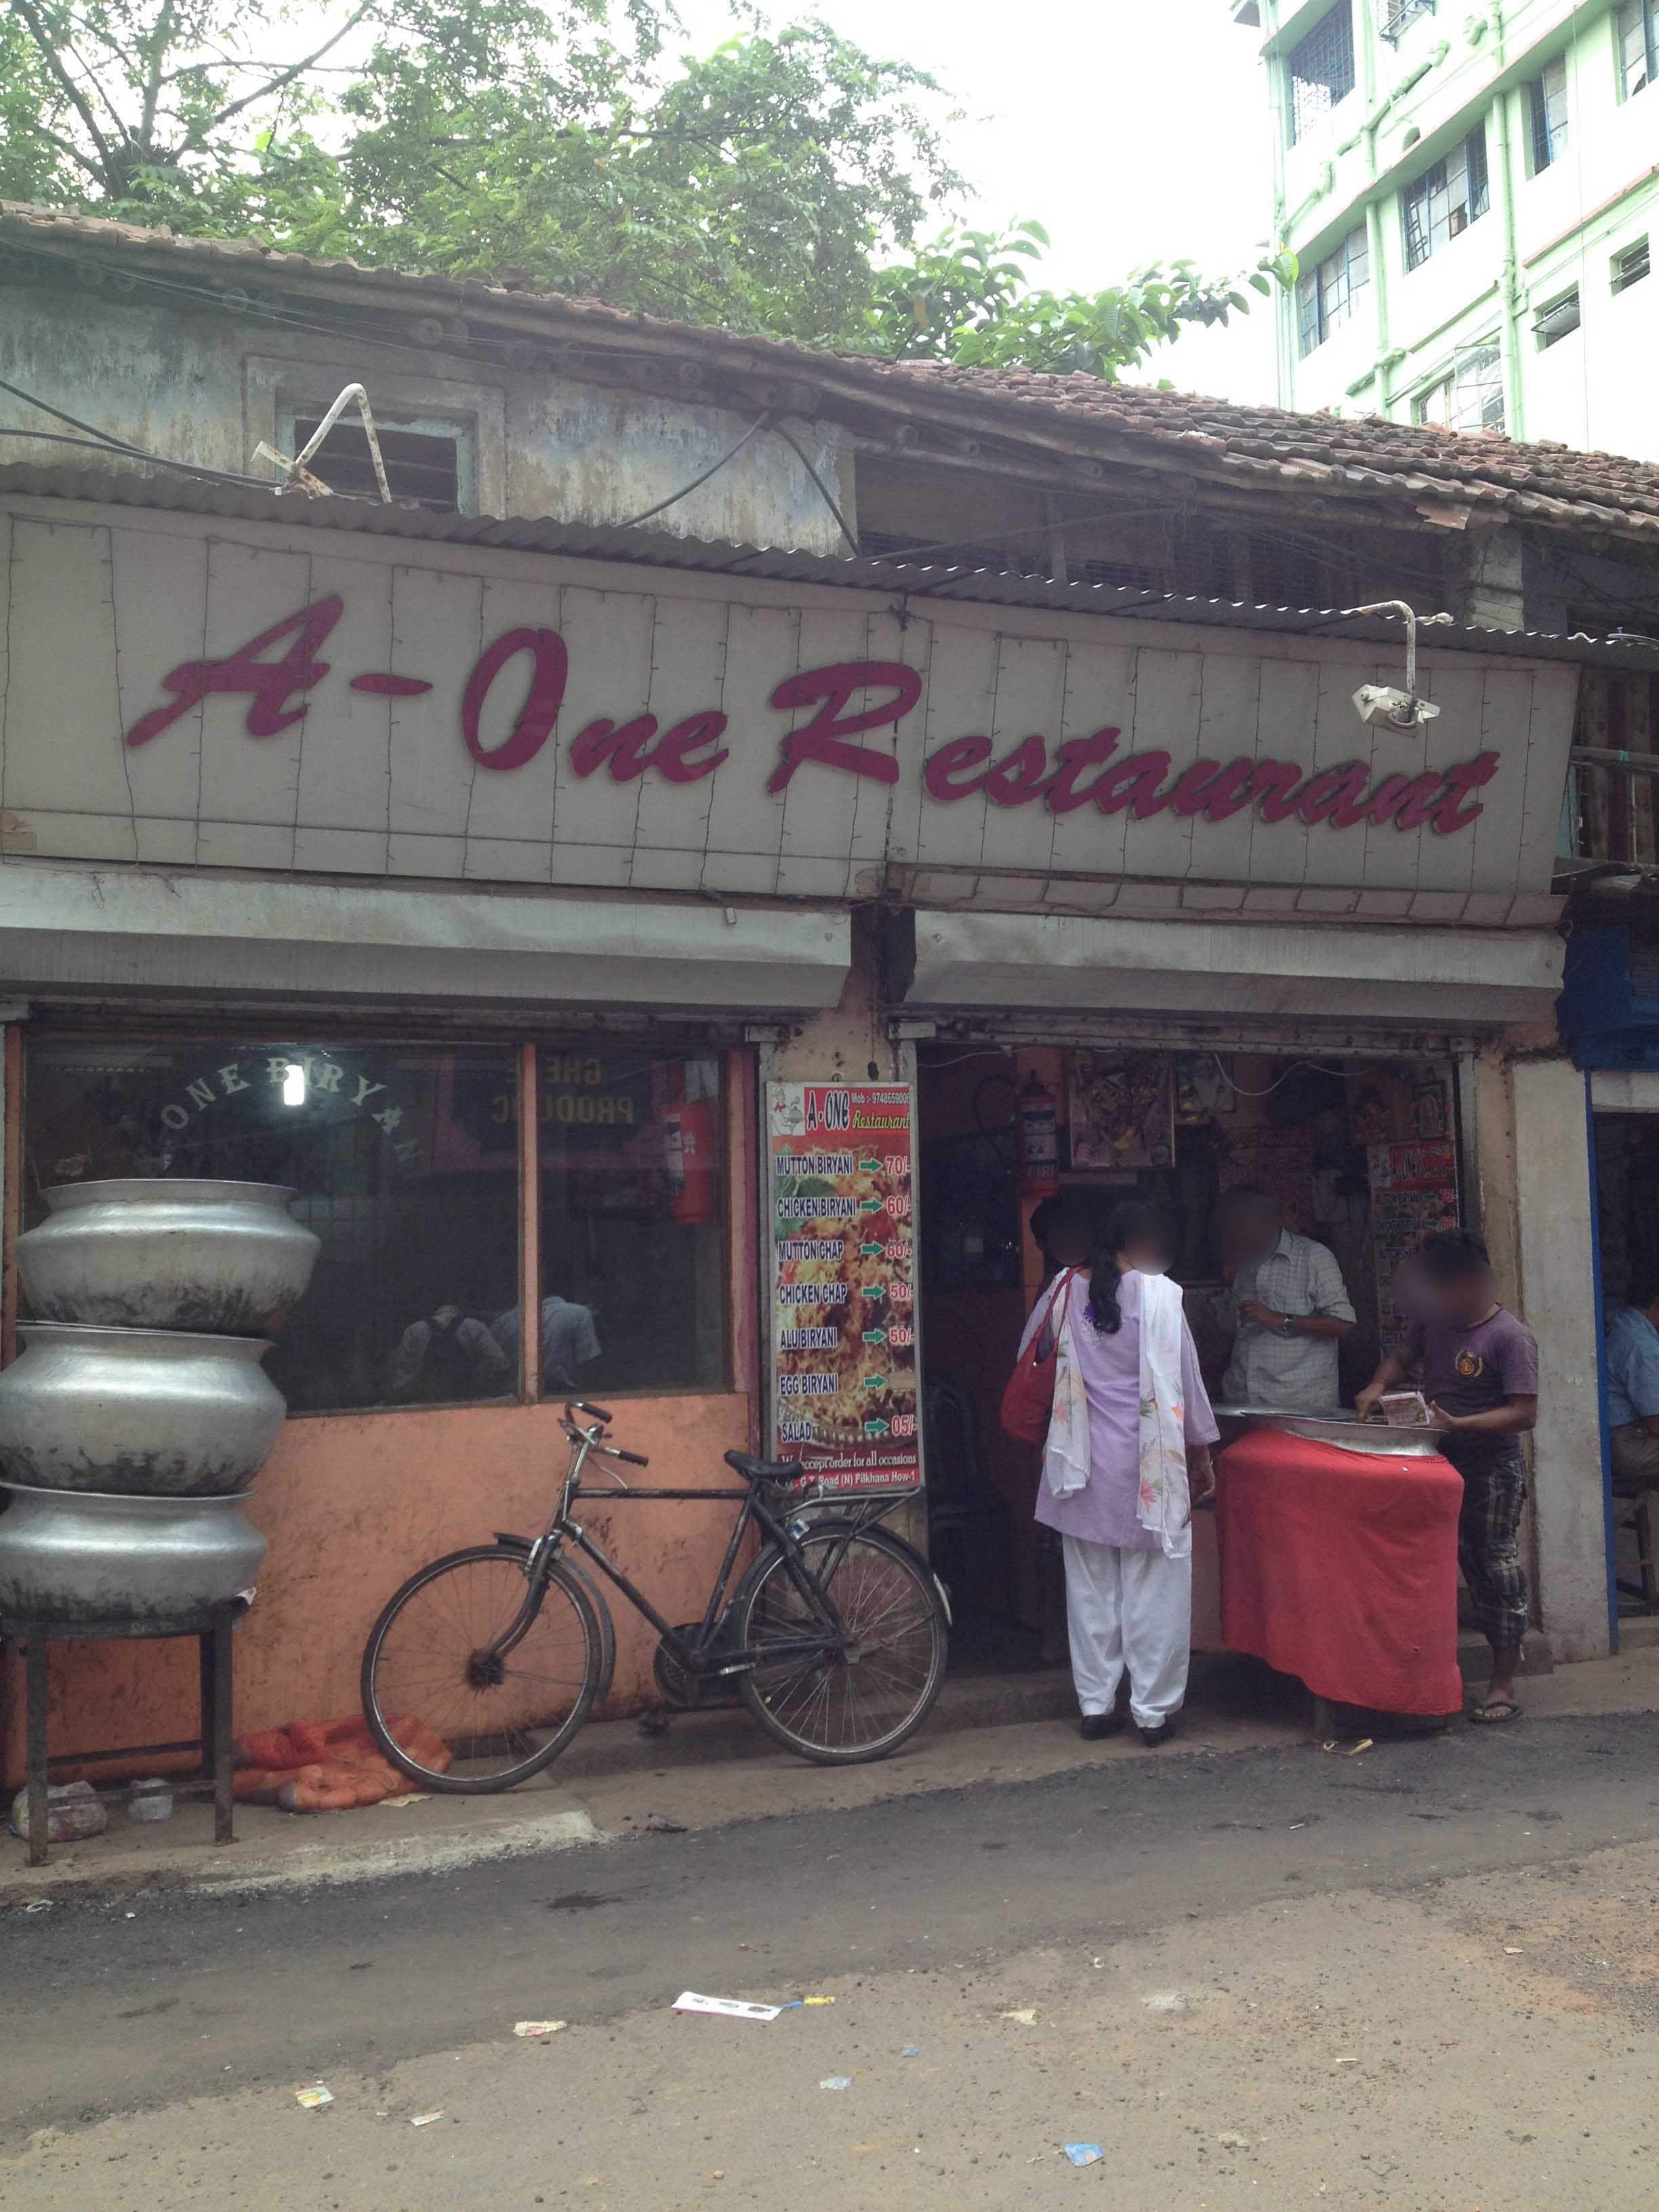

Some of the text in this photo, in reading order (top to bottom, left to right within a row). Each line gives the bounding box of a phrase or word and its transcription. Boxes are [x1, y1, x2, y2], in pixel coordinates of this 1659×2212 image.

[125, 592, 1501, 836] A-One Restaurant
[160, 1063, 251, 1130] ONE
[806, 1090, 910, 1131] A-ONE Restaurant
[776, 1155, 815, 1176] MUTTON
[817, 1155, 853, 1175] BIRYANI
[777, 1197, 818, 1218] CHICKEN
[819, 1197, 857, 1217] BIRYANI
[778, 1241, 817, 1262] MUTTON
[818, 1240, 845, 1260] CHAP
[779, 1284, 821, 1305] CHICKEN
[821, 1283, 847, 1303] CHAP
[780, 1329, 798, 1349] ALU
[800, 1327, 838, 1349] BIRYANI
[779, 1374, 839, 1396] EGG BIRYANI
[781, 1420, 812, 1443] SALAD
[828, 1452, 852, 1469] order
[853, 1452, 865, 1468] for
[865, 1450, 878, 1467] all
[878, 1453, 917, 1466] occasions
[841, 1473, 853, 1488] (N)
[855, 1472, 890, 1484] Pilkhana
[891, 1470, 916, 1482] How-1
